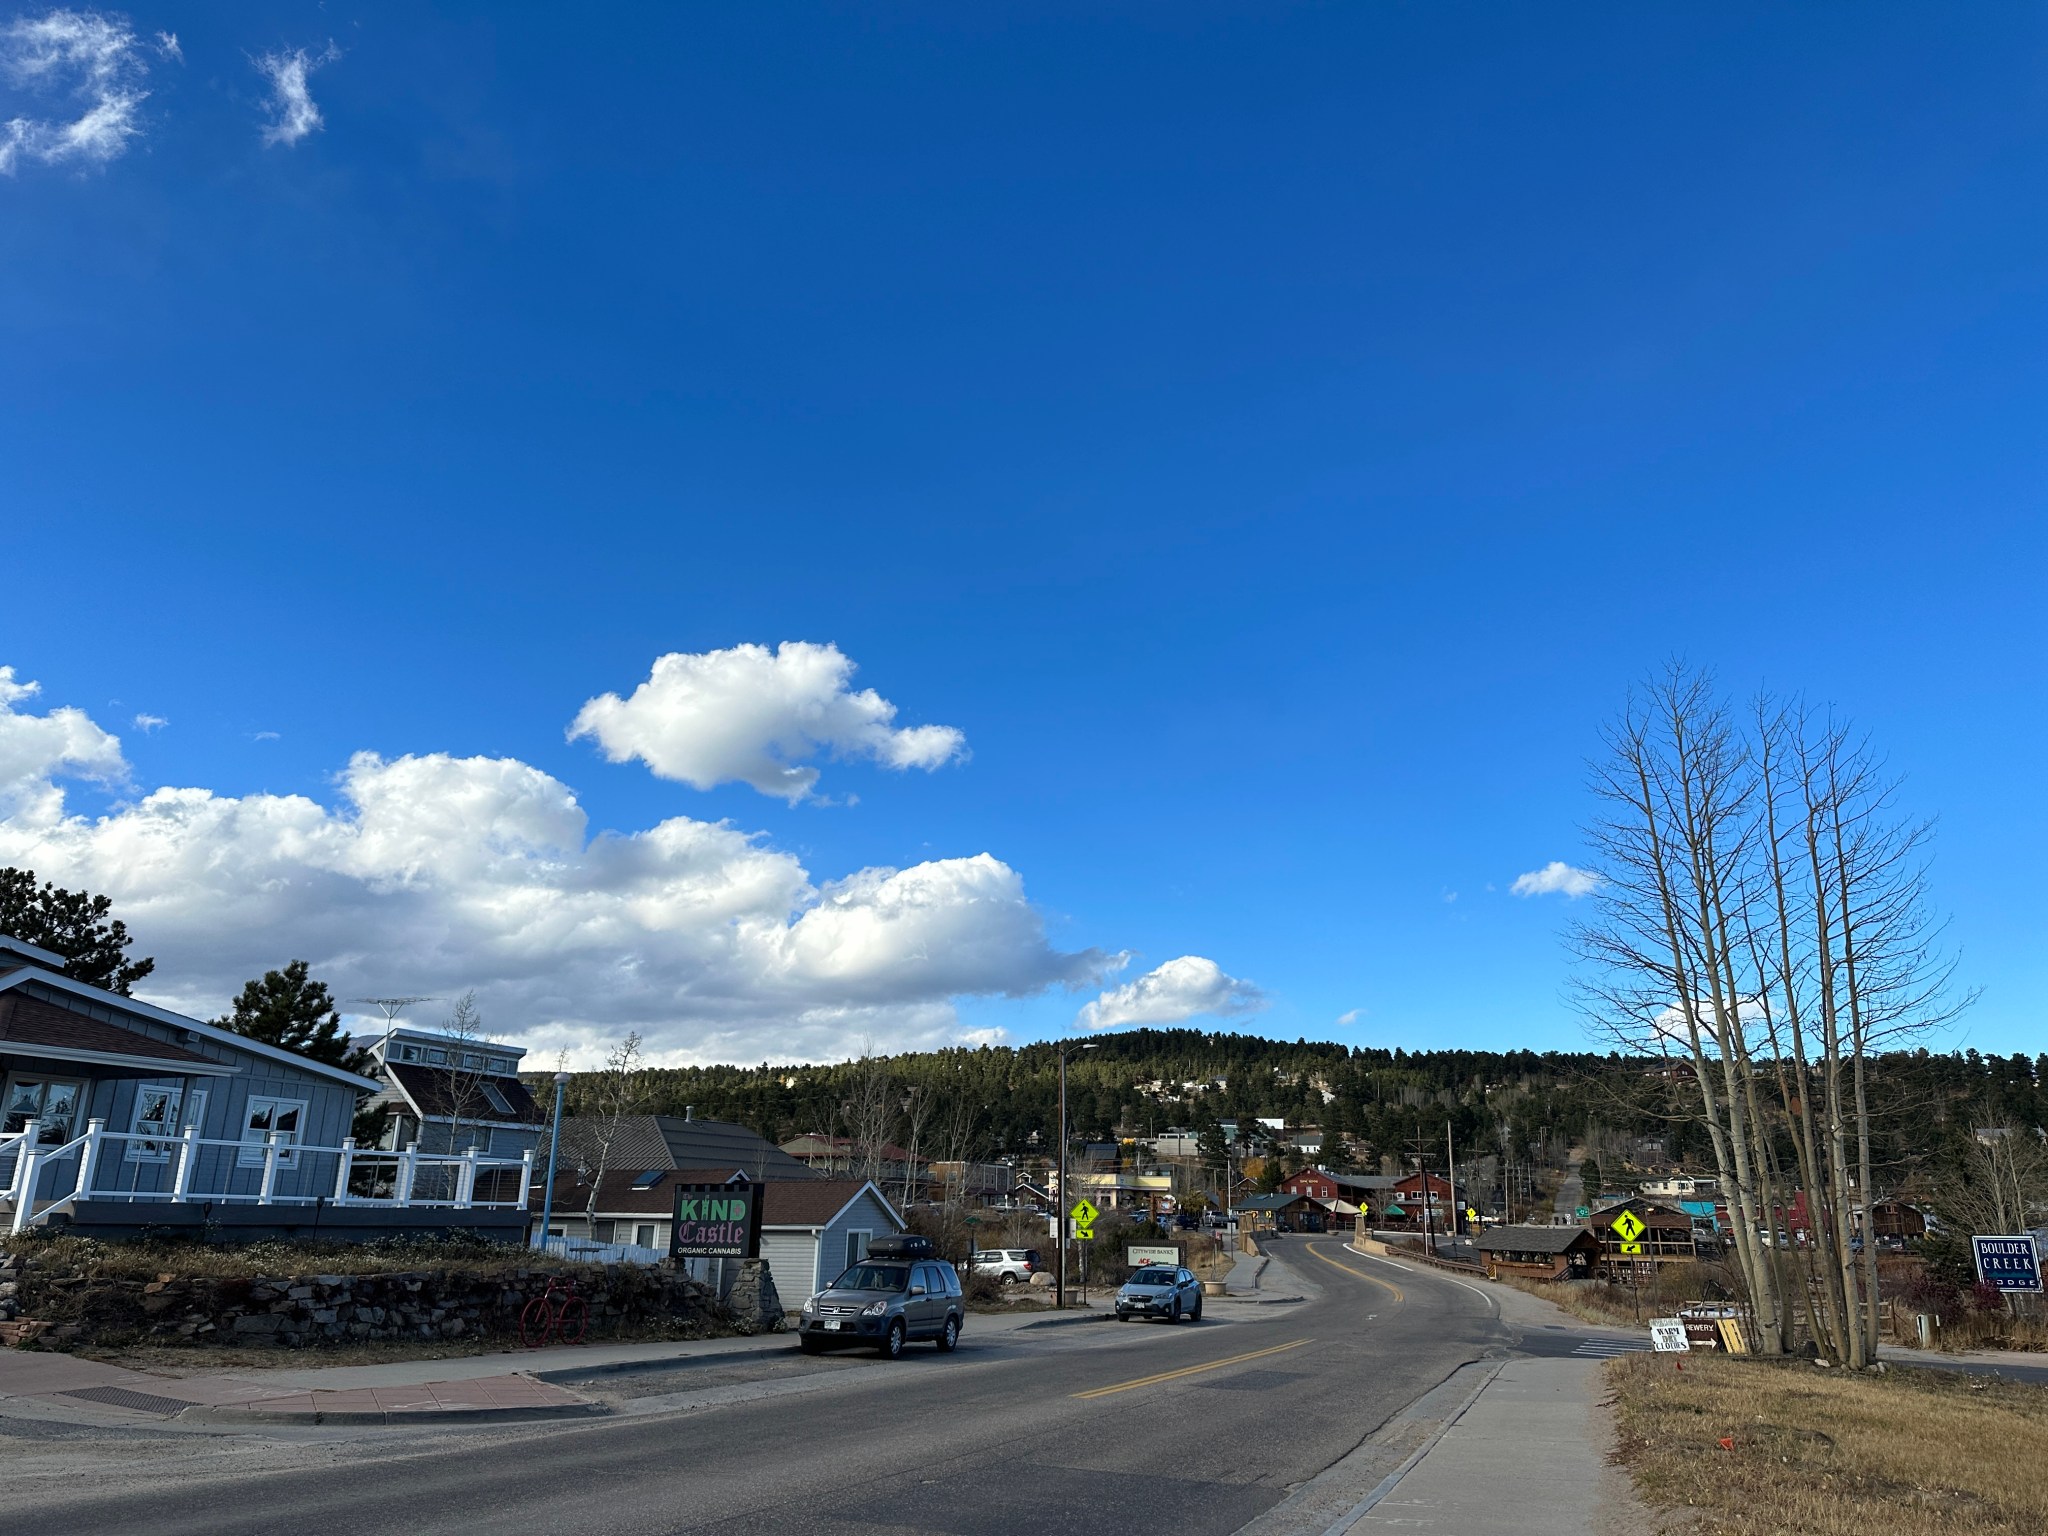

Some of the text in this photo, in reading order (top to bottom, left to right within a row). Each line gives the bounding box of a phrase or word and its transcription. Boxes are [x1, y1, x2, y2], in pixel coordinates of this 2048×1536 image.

[680, 1199, 746, 1221] KIND
[678, 1221, 744, 1244] Castle
[677, 1247, 742, 1255] ORGANIC CANNABIS
[1981, 1243, 2029, 1254] BOULDER
[1983, 1258, 2033, 1270] CREEK
[1656, 1327, 1680, 1335] WARM
